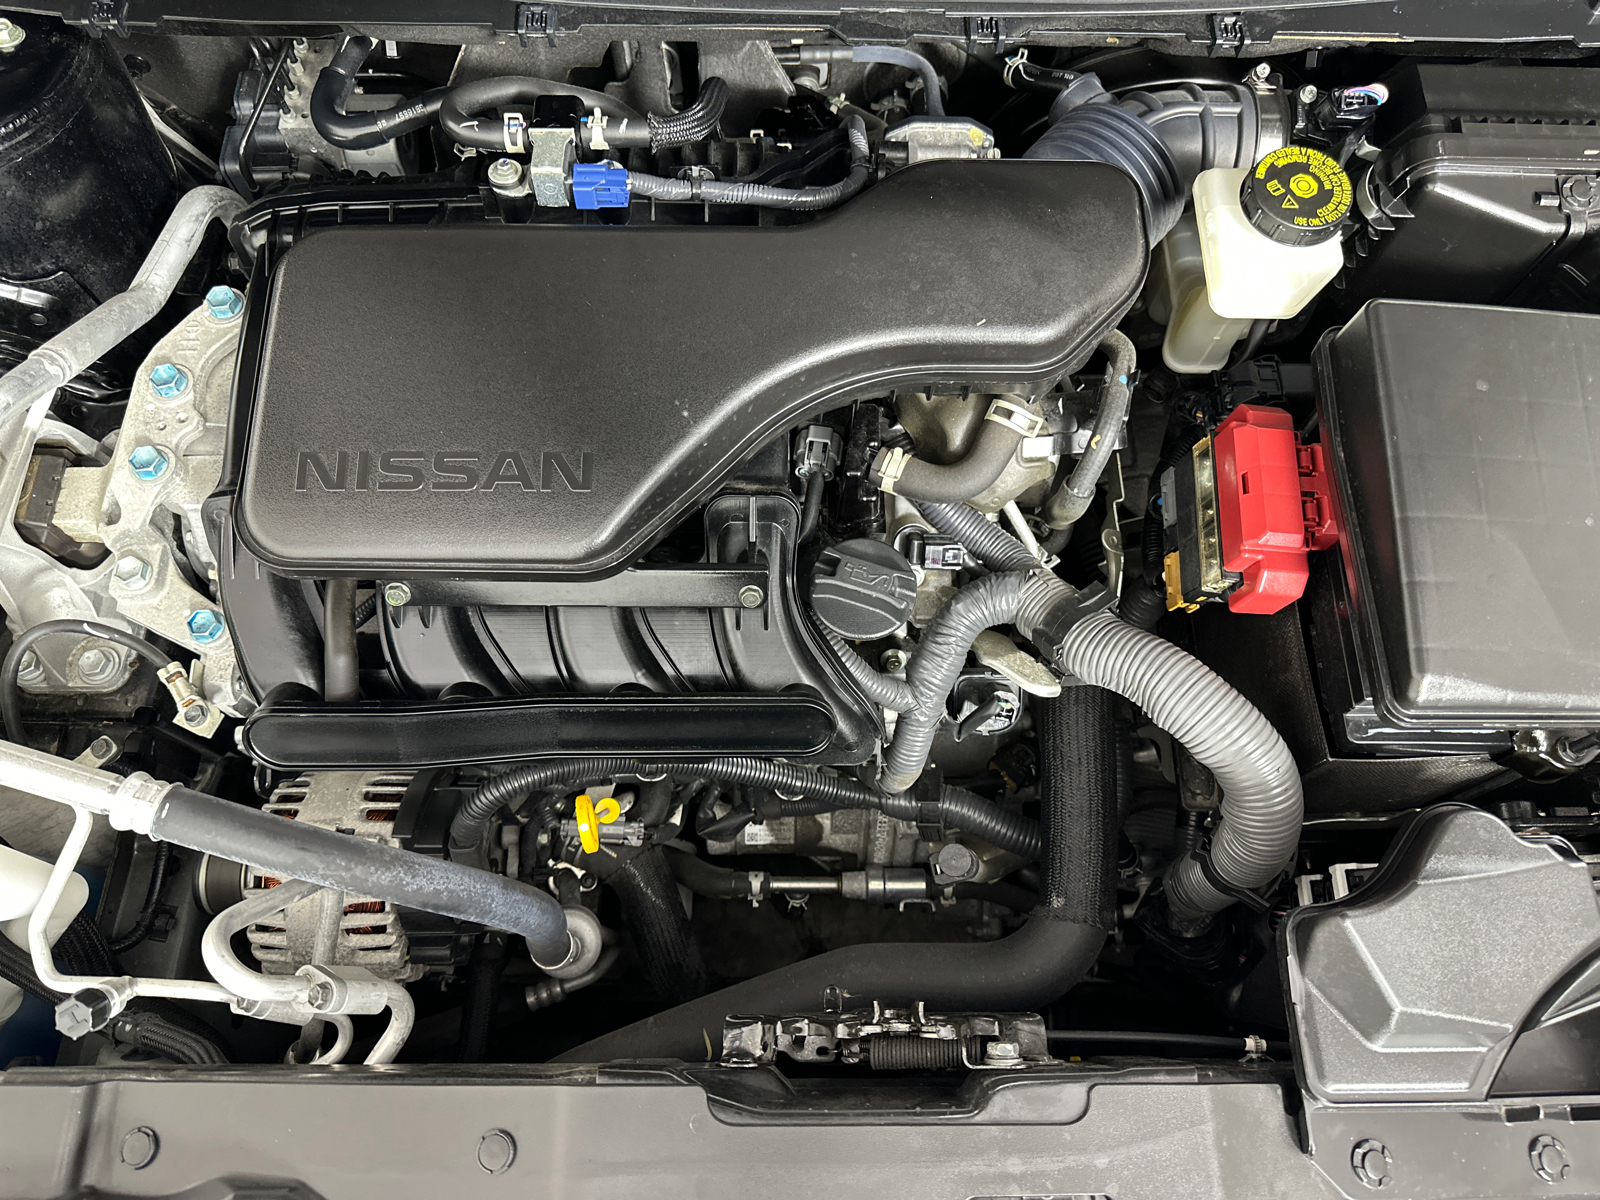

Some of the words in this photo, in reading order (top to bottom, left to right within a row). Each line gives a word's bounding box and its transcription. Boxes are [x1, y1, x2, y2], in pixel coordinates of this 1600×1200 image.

[1274, 147, 1300, 159] SEALED
[1300, 147, 1307, 156] A
[1306, 148, 1327, 162] FROM
[1274, 154, 1307, 167] REMOVING
[1308, 156, 1335, 176] BEFORE
[1324, 157, 1342, 173] FLUID
[1310, 164, 1333, 189] WARNING
[1329, 174, 1341, 187] CAP
[1336, 171, 1352, 190] BRAKE
[1330, 186, 1342, 205] FILLER
[1317, 202, 1338, 218] CLEAN
[1325, 210, 1342, 223] DOT3
[1294, 216, 1308, 226] USE
[1308, 217, 1327, 226] ONLY
[295, 450, 594, 492] NISSAN
